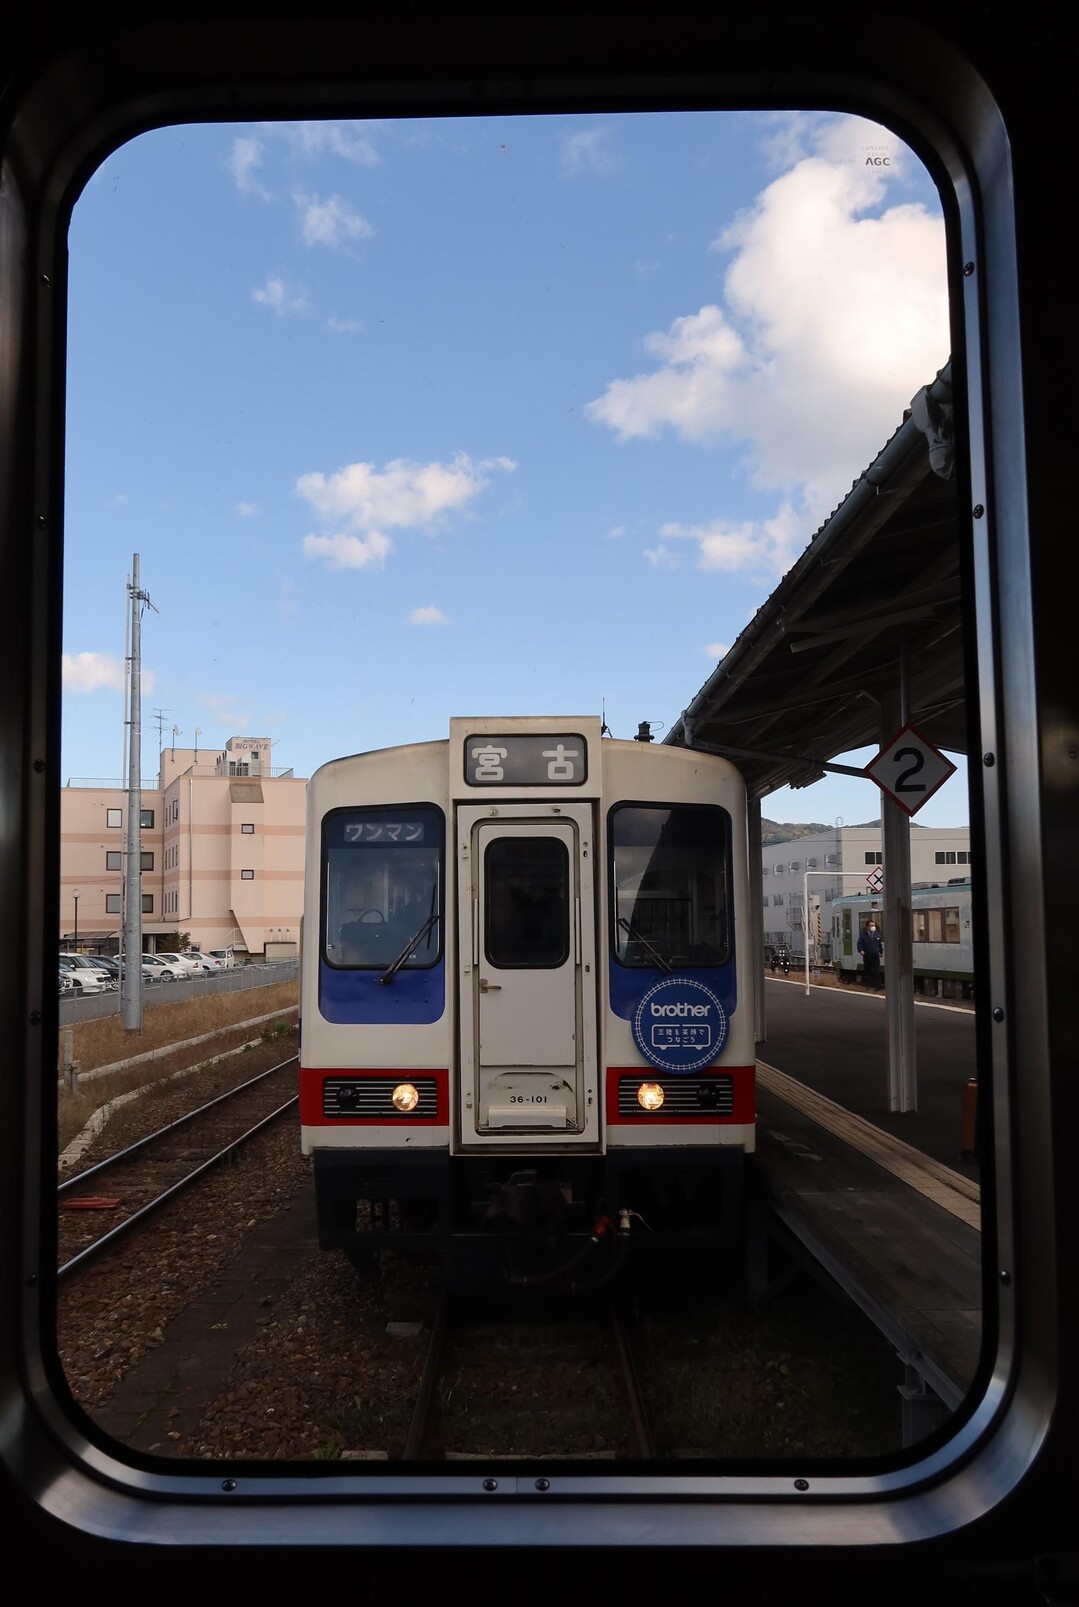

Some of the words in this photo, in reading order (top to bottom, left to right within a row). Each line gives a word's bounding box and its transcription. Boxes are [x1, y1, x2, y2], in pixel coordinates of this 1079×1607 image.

[865, 157, 890, 166] AGC
[893, 747, 926, 792] 2
[346, 824, 422, 840] ワンマン
[651, 1003, 710, 1016] brother
